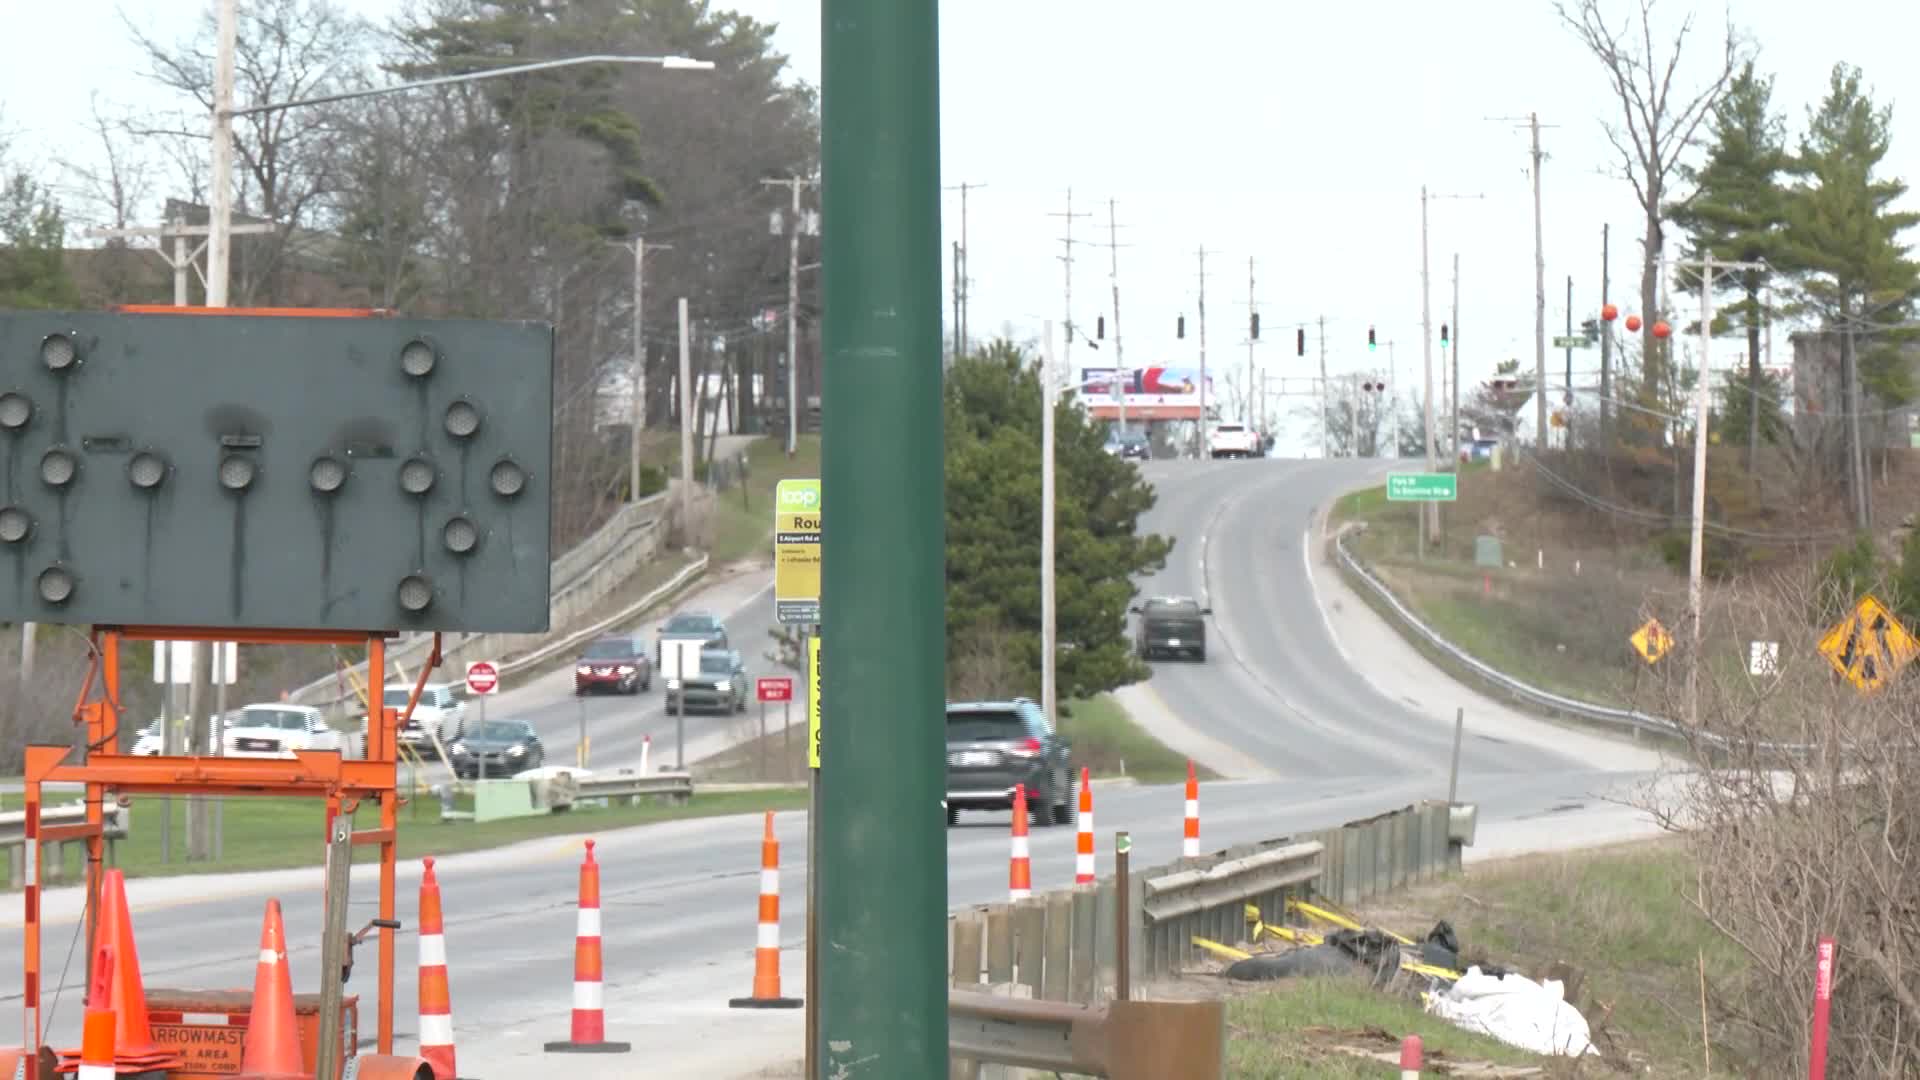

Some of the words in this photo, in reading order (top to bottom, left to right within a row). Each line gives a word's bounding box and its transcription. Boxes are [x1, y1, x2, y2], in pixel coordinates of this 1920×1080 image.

[781, 487, 817, 507] loop
[784, 535, 804, 543] Airport
[197, 1049, 229, 1059] AREA
